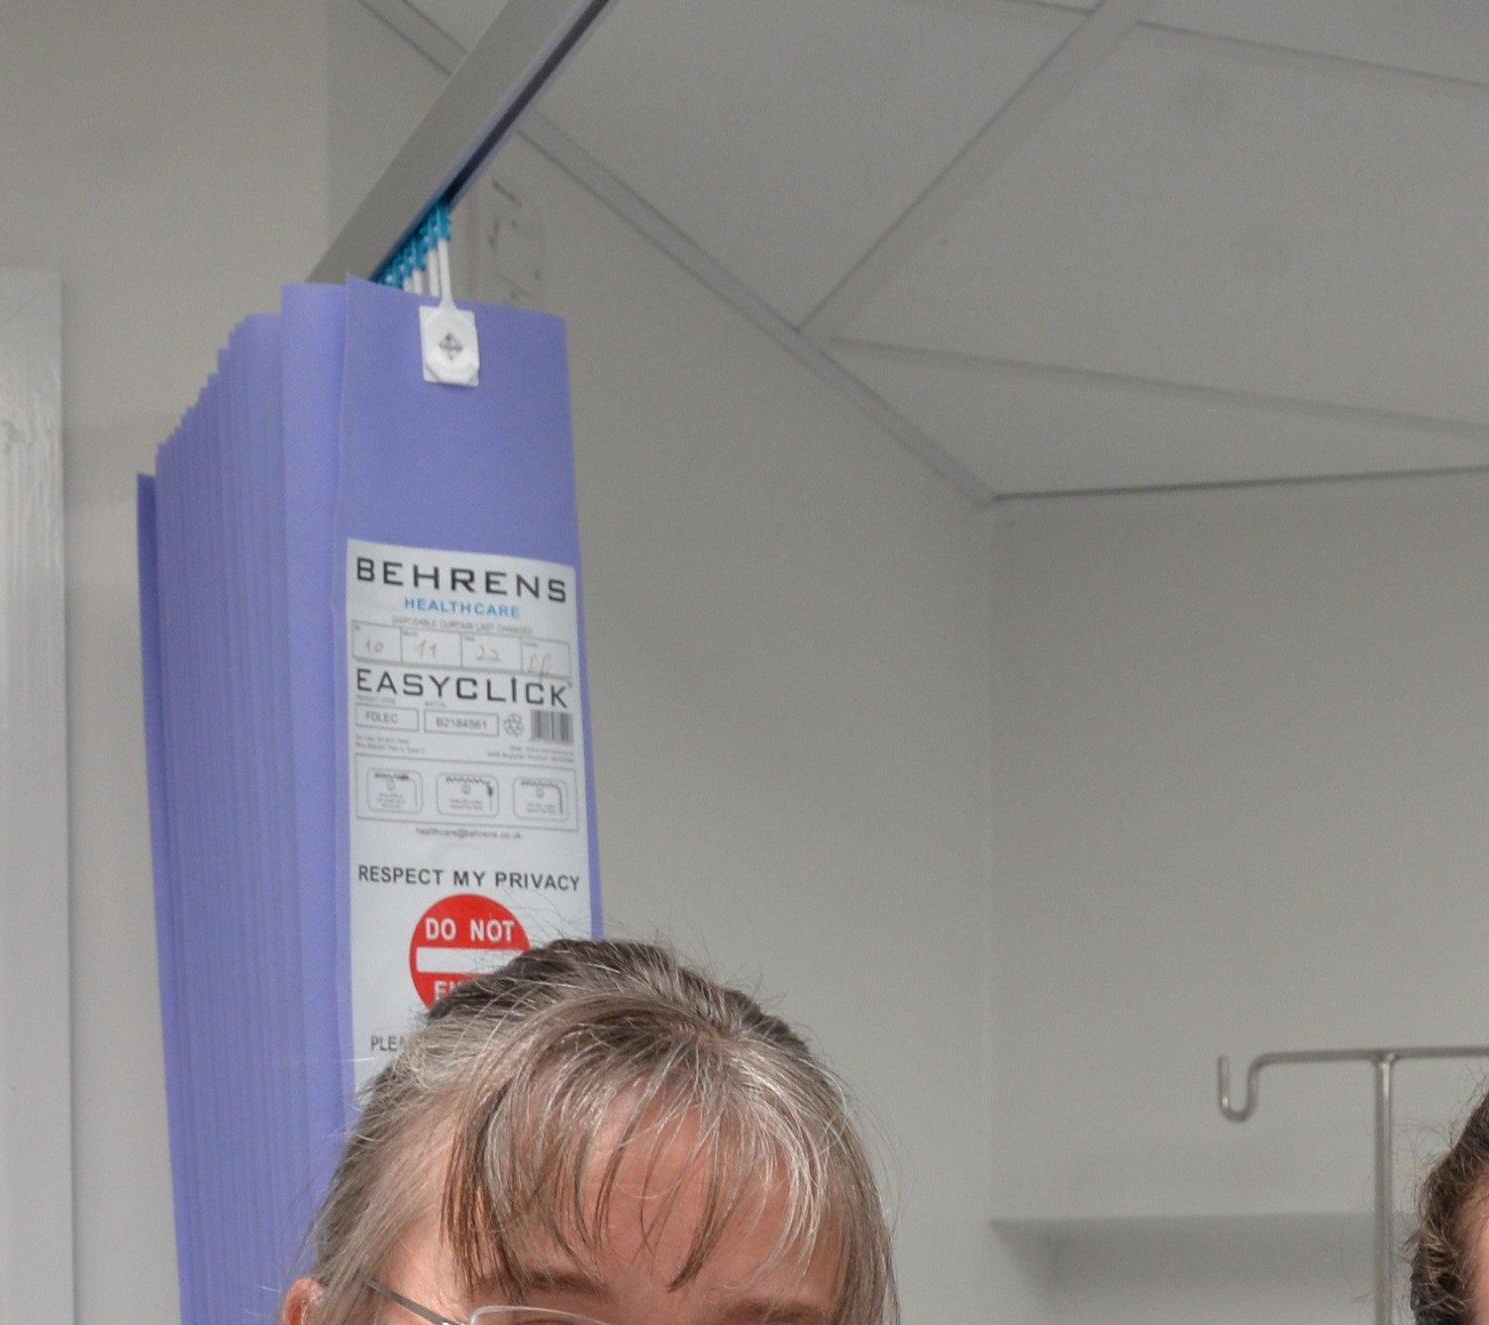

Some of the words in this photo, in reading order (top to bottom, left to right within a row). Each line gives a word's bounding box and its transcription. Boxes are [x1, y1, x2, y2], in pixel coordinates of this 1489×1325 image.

[355, 556, 567, 603] BEHRENS
[404, 597, 521, 619] HEALTHCARE
[356, 668, 567, 708] EASYCLICK
[358, 864, 444, 885] RESPECT
[453, 870, 485, 887] MY
[495, 871, 580, 891] PRIVACY
[425, 917, 457, 940] DO
[470, 919, 515, 941] NOT
